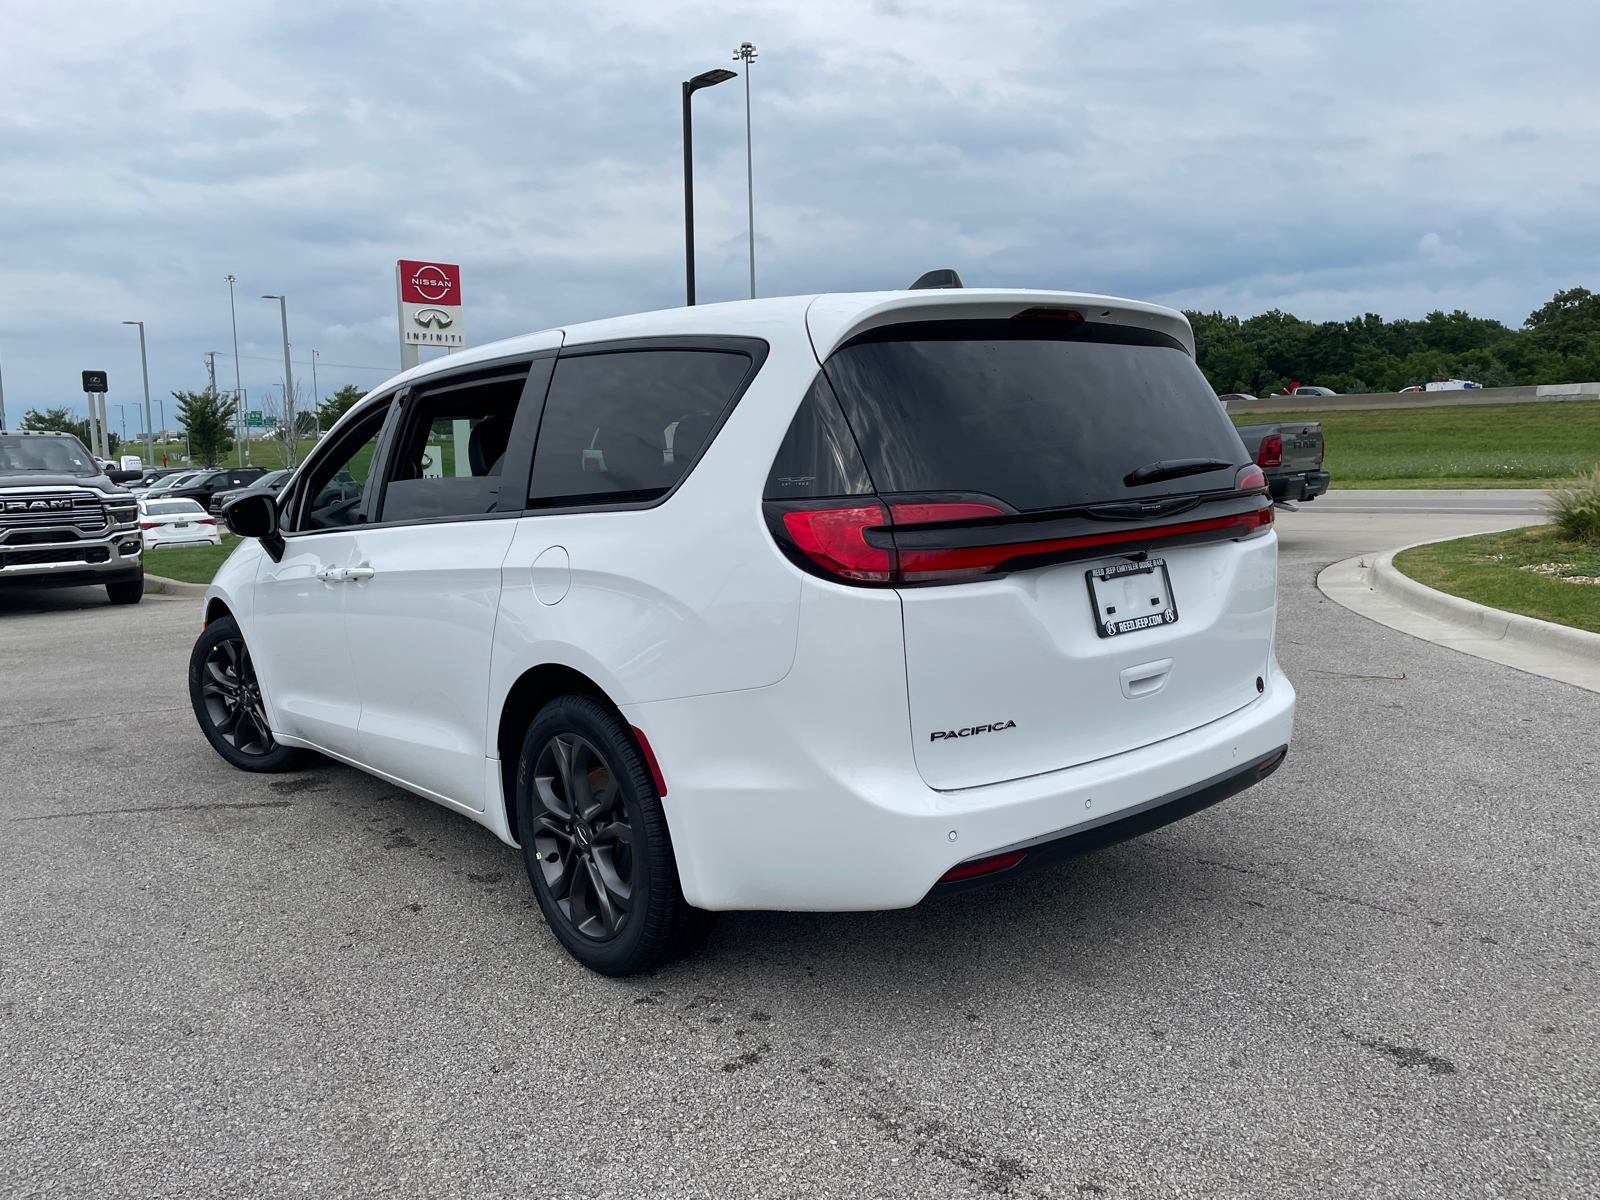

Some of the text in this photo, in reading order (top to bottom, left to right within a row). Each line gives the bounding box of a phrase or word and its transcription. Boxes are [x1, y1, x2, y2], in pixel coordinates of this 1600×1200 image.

[412, 278, 452, 287] NISSAN
[406, 332, 462, 343] INFINITI
[1294, 440, 1316, 449] RAM
[6, 500, 71, 510] RAM
[1092, 569, 1104, 577] REED
[1105, 566, 1116, 574] JEEP
[1117, 563, 1139, 573] CHRYSLER
[1139, 561, 1153, 569] DODGE
[1119, 615, 1163, 633] REEDJEEP.COM
[930, 719, 1017, 742] PACIFICA
